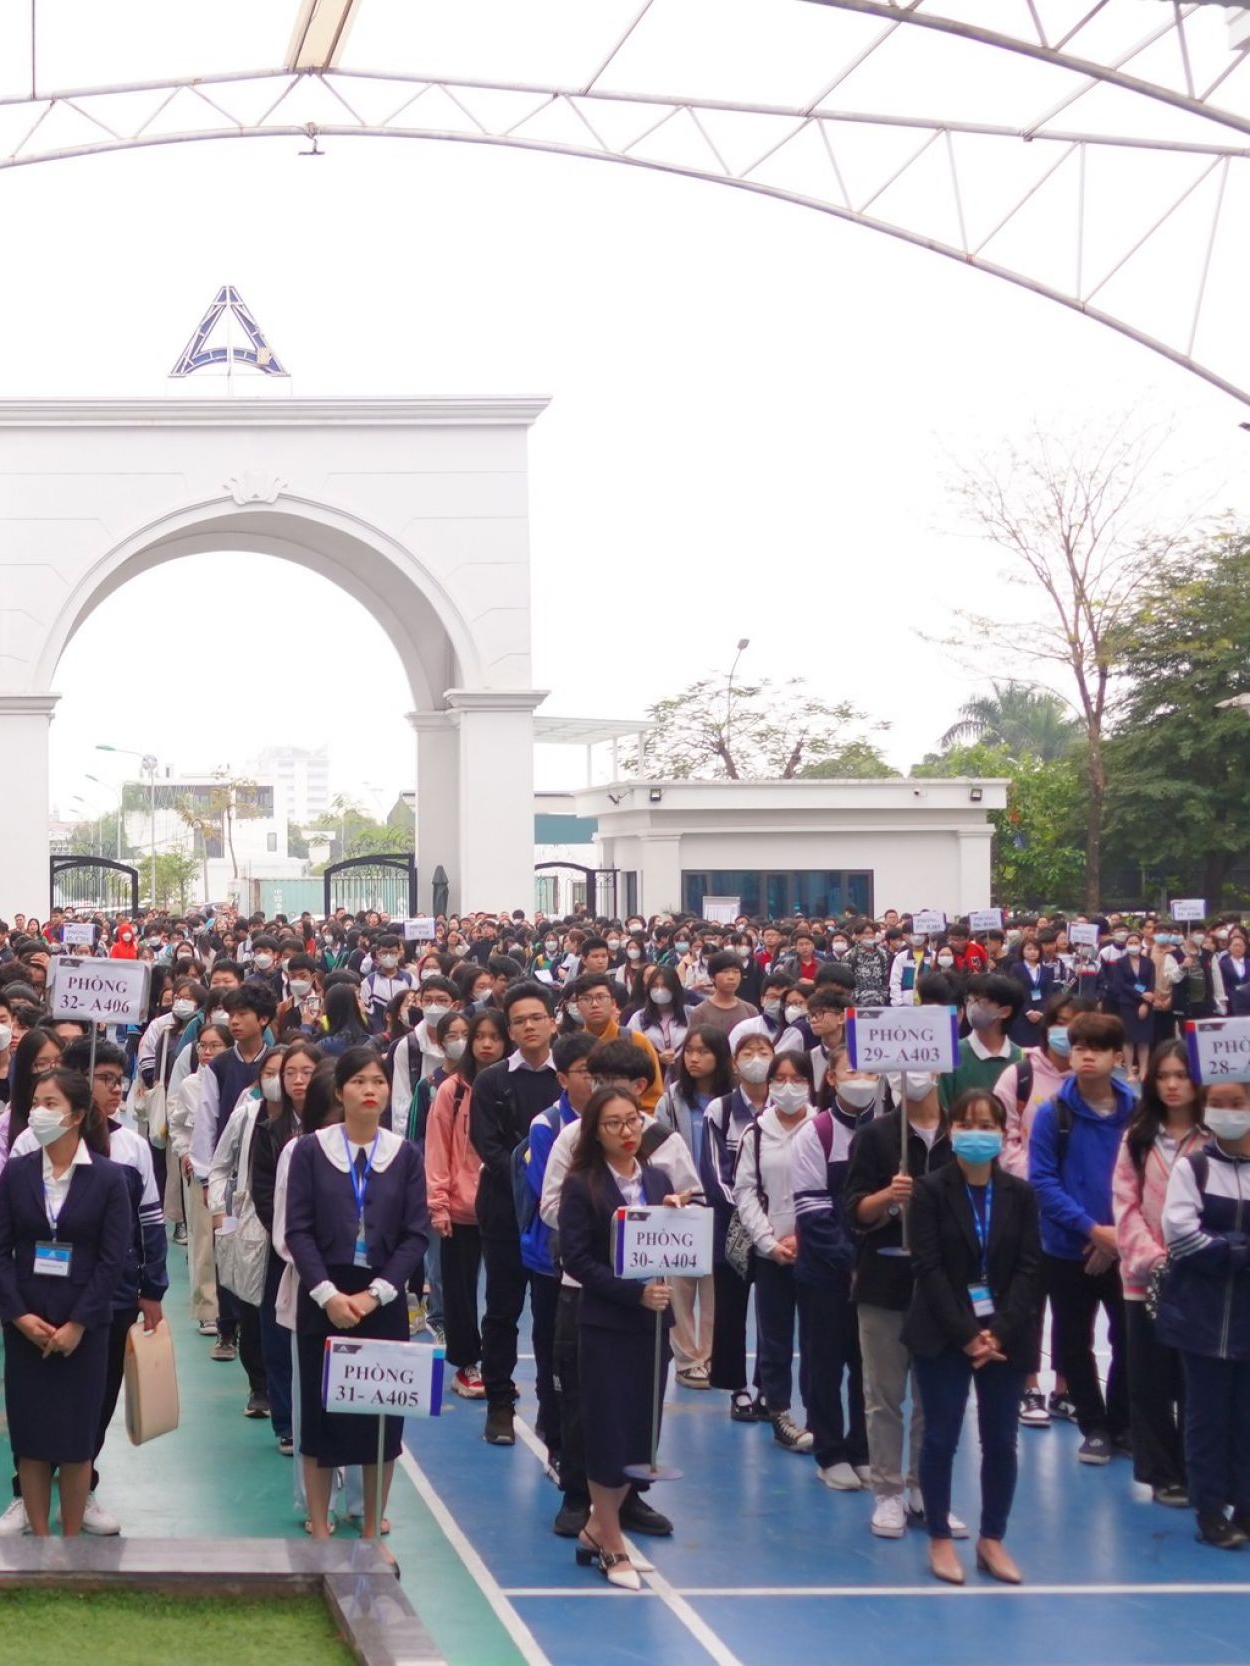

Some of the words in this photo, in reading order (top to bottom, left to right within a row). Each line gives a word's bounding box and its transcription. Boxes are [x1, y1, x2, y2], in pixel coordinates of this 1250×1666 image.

[60, 994, 85, 1009] 32-
[90, 998, 129, 1013] A406
[863, 1047, 890, 1062] 29-
[897, 1047, 940, 1062] A403
[630, 1252, 654, 1267] 30-
[659, 1253, 697, 1268] A404
[335, 1385, 364, 1402] 31-
[370, 1389, 419, 1408] A405
